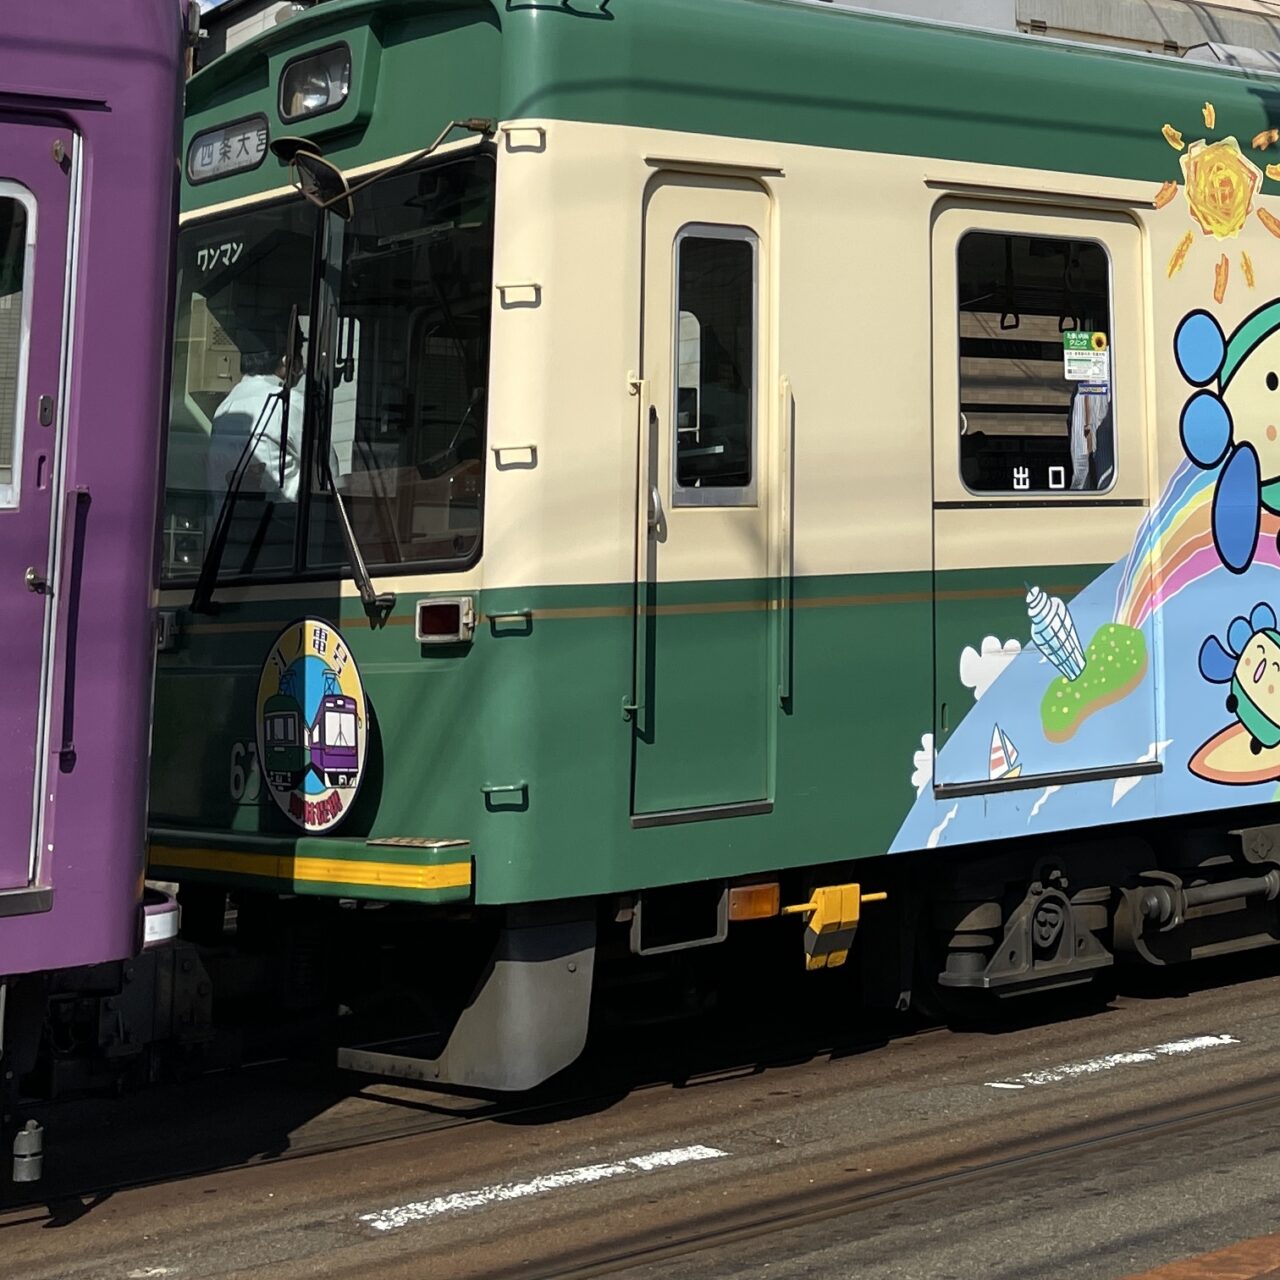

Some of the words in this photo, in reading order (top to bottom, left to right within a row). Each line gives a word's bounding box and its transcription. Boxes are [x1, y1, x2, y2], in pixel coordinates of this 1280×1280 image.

[197, 241, 244, 271] ワンマン
[1013, 466, 1065, 489] 出口
